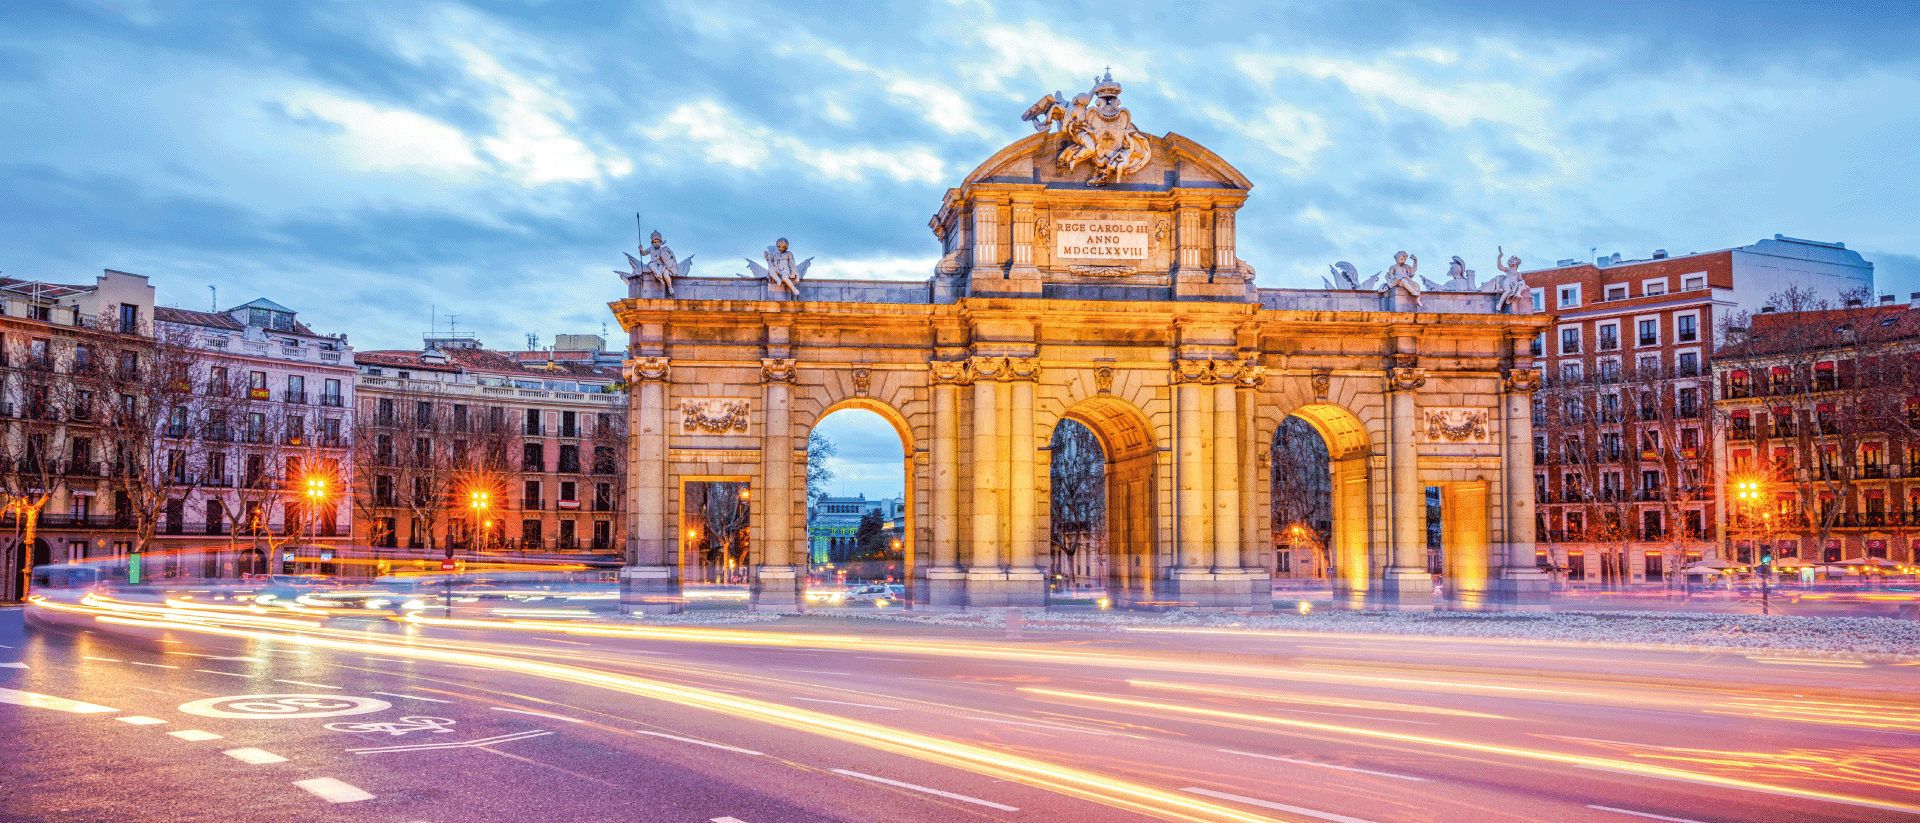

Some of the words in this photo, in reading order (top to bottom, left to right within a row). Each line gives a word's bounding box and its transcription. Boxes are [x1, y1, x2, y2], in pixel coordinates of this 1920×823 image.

[1057, 223, 1086, 232] REGE
[1089, 224, 1133, 233] CAROLO
[1137, 225, 1149, 234] III
[1086, 235, 1120, 244] ANNO
[1063, 246, 1142, 256] MDCCLXXVIII
[228, 699, 351, 713] 30
